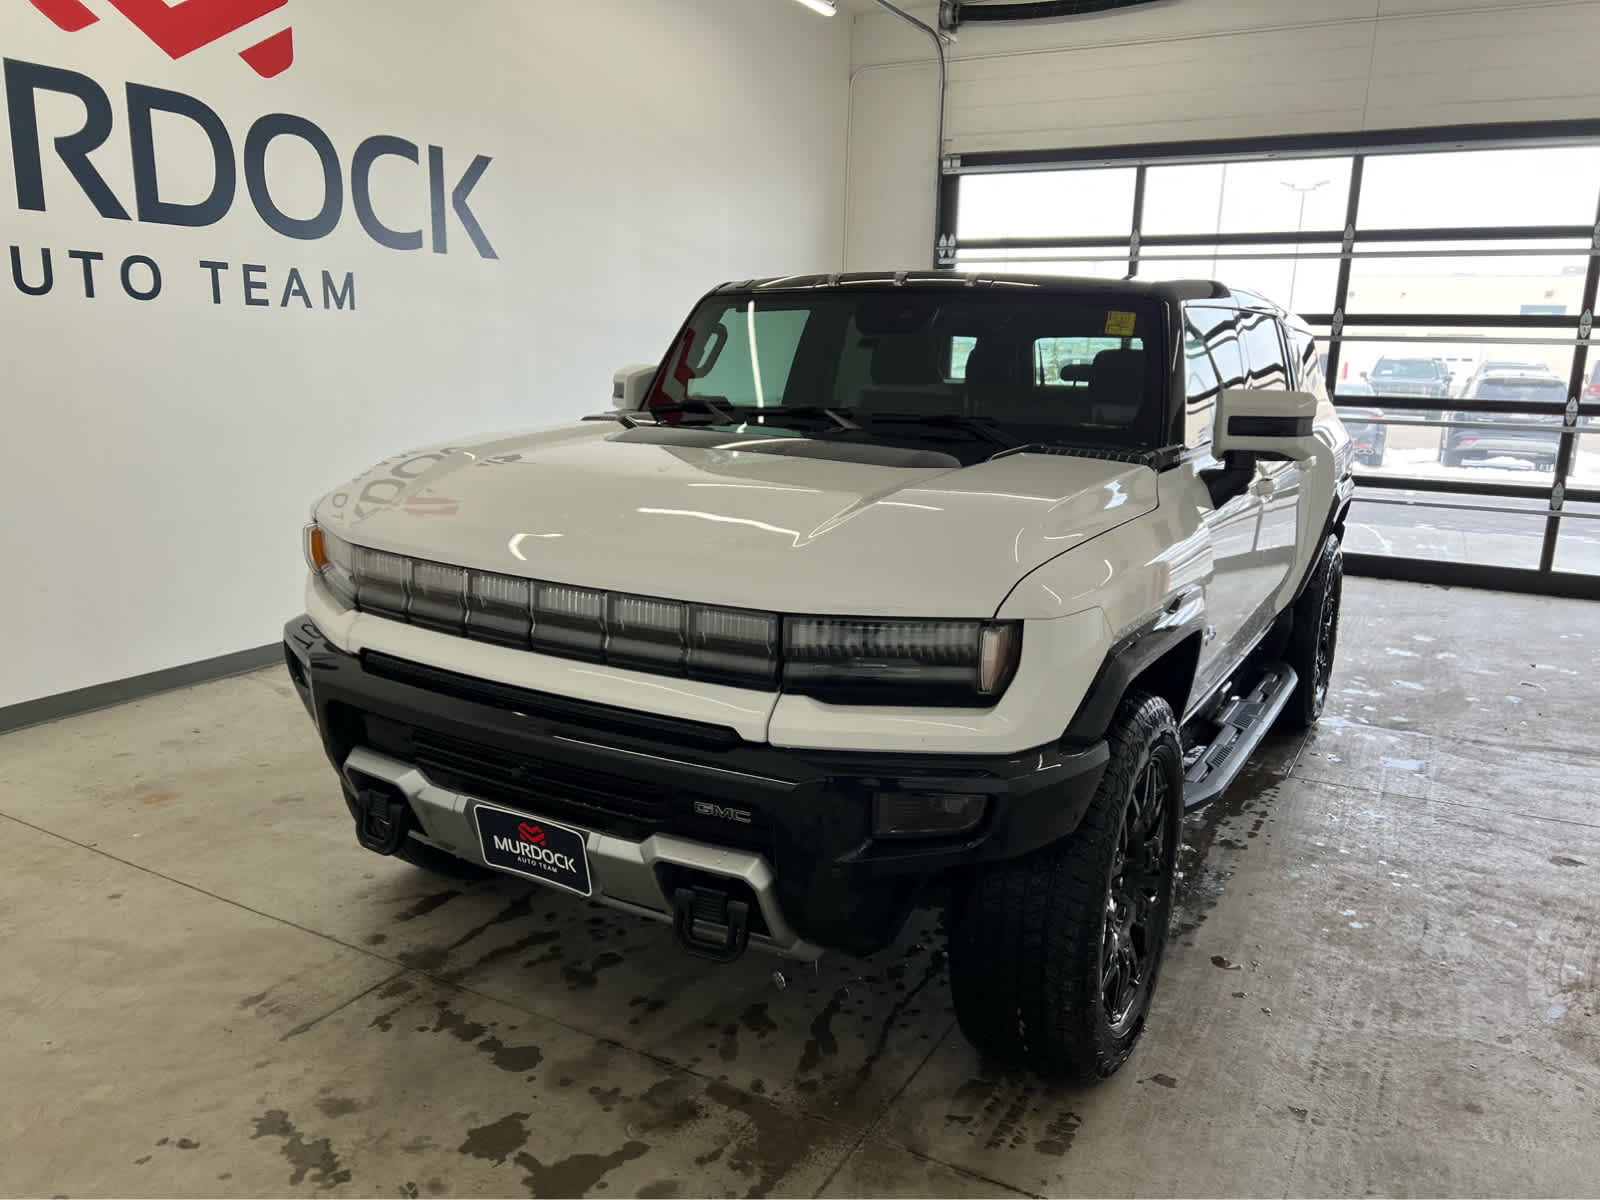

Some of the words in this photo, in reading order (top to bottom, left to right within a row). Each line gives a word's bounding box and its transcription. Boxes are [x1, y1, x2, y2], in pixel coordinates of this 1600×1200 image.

[200, 260, 357, 311] TEAM
[695, 802, 752, 823] GMC
[493, 835, 577, 873] MURDOCK
[517, 856, 536, 866] AUTO
[539, 862, 558, 873] TEAM
